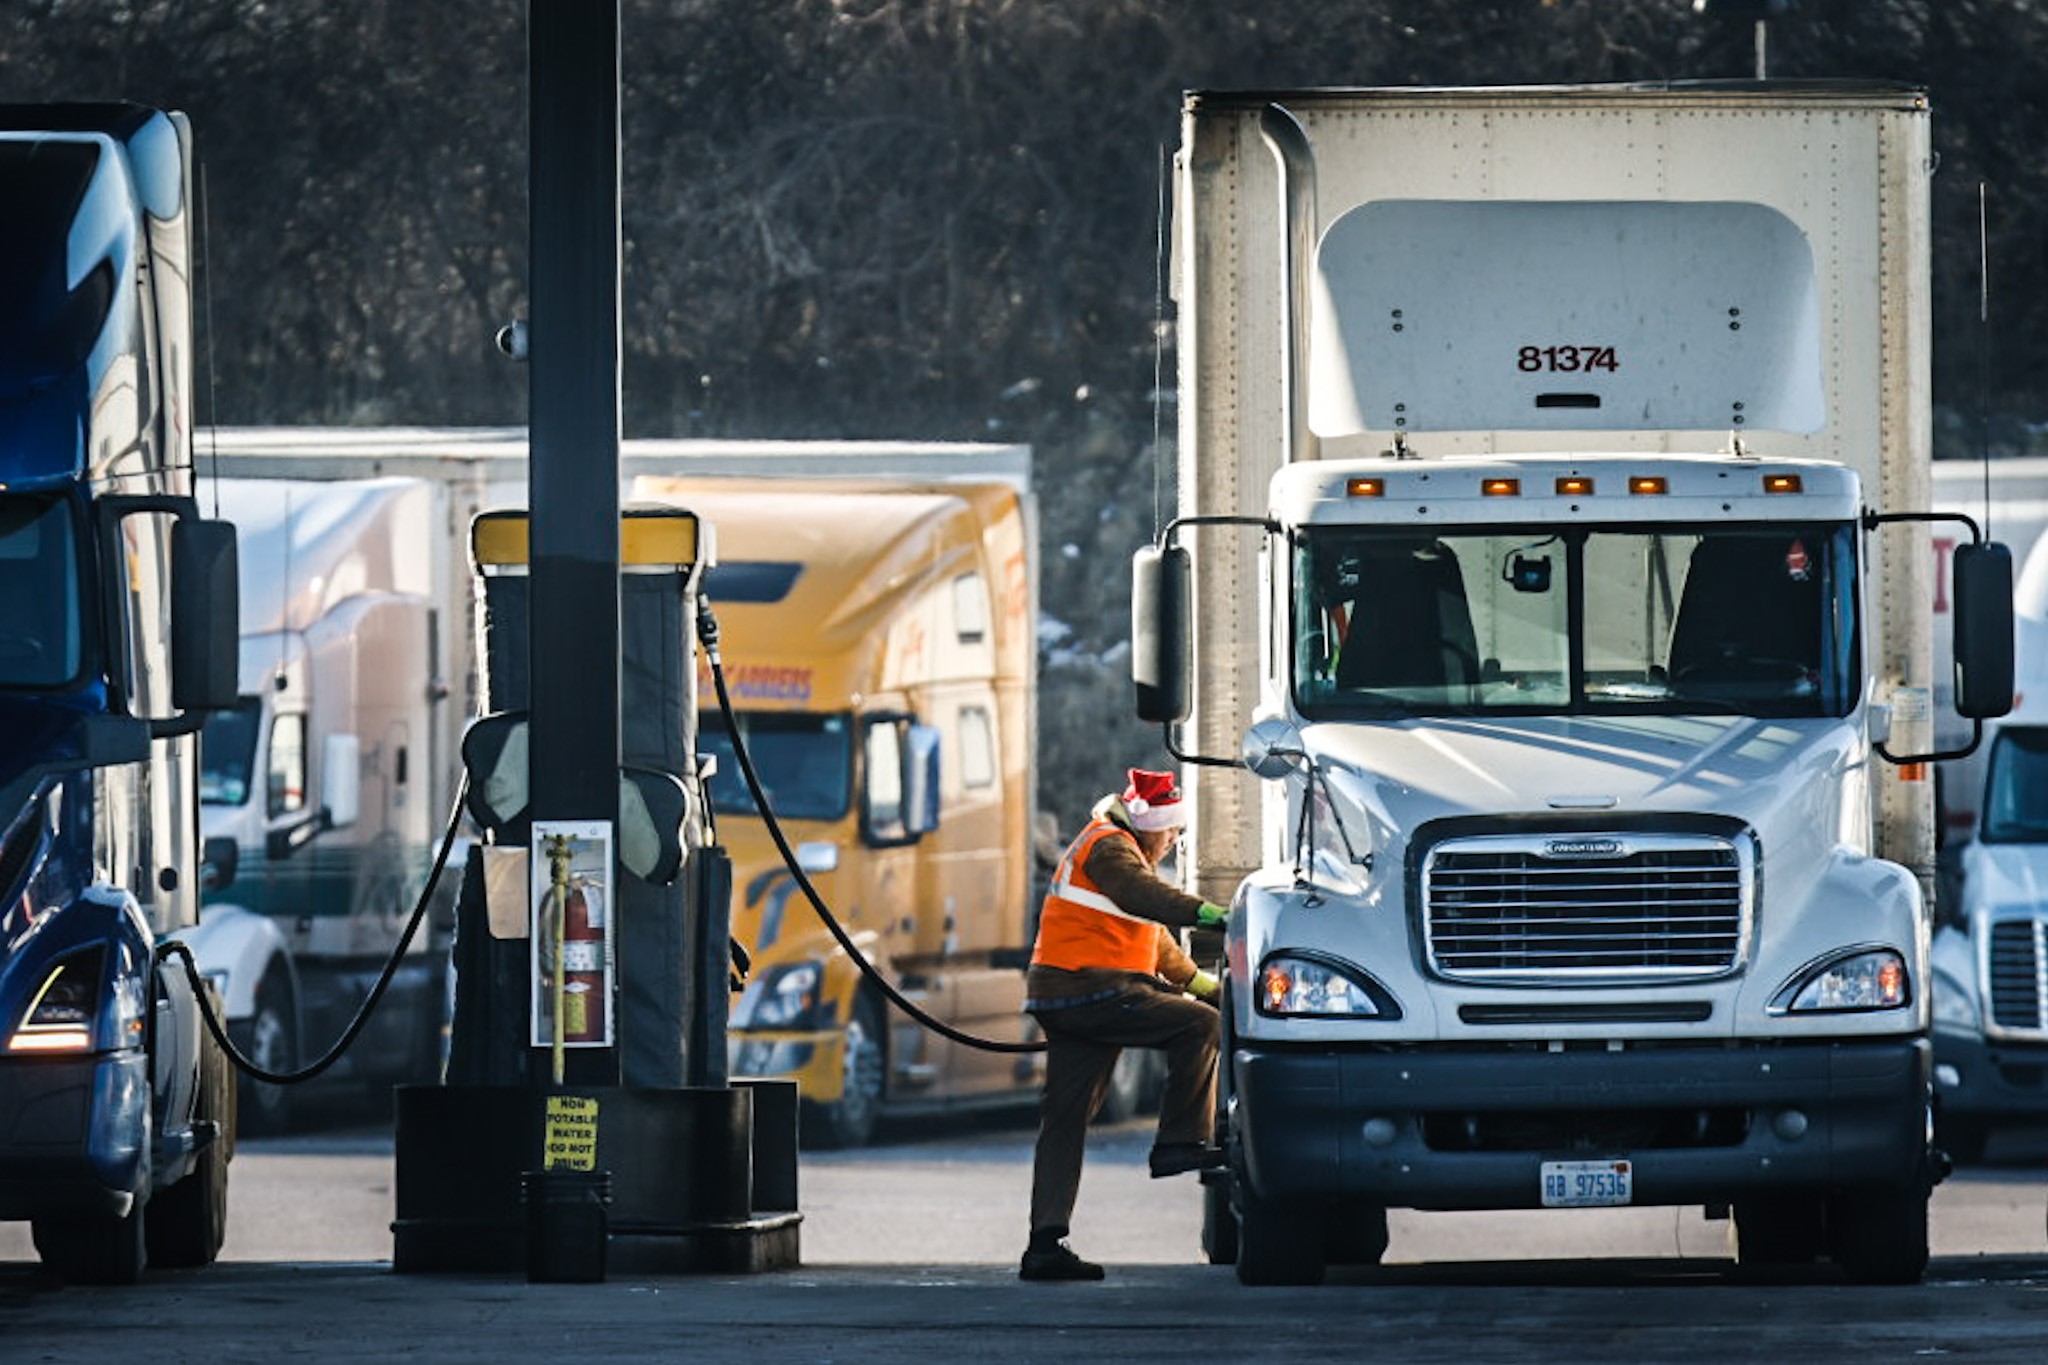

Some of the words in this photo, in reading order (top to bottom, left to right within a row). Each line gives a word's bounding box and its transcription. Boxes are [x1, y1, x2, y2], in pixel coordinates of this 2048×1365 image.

[1517, 345, 1620, 372] 81374
[560, 1097, 586, 1109] NON
[547, 1113, 597, 1124] POTABLE
[552, 1128, 592, 1138] WATER
[550, 1143, 566, 1153] DO
[568, 1144, 592, 1154] NOT
[1575, 1173, 1627, 1196] 97536
